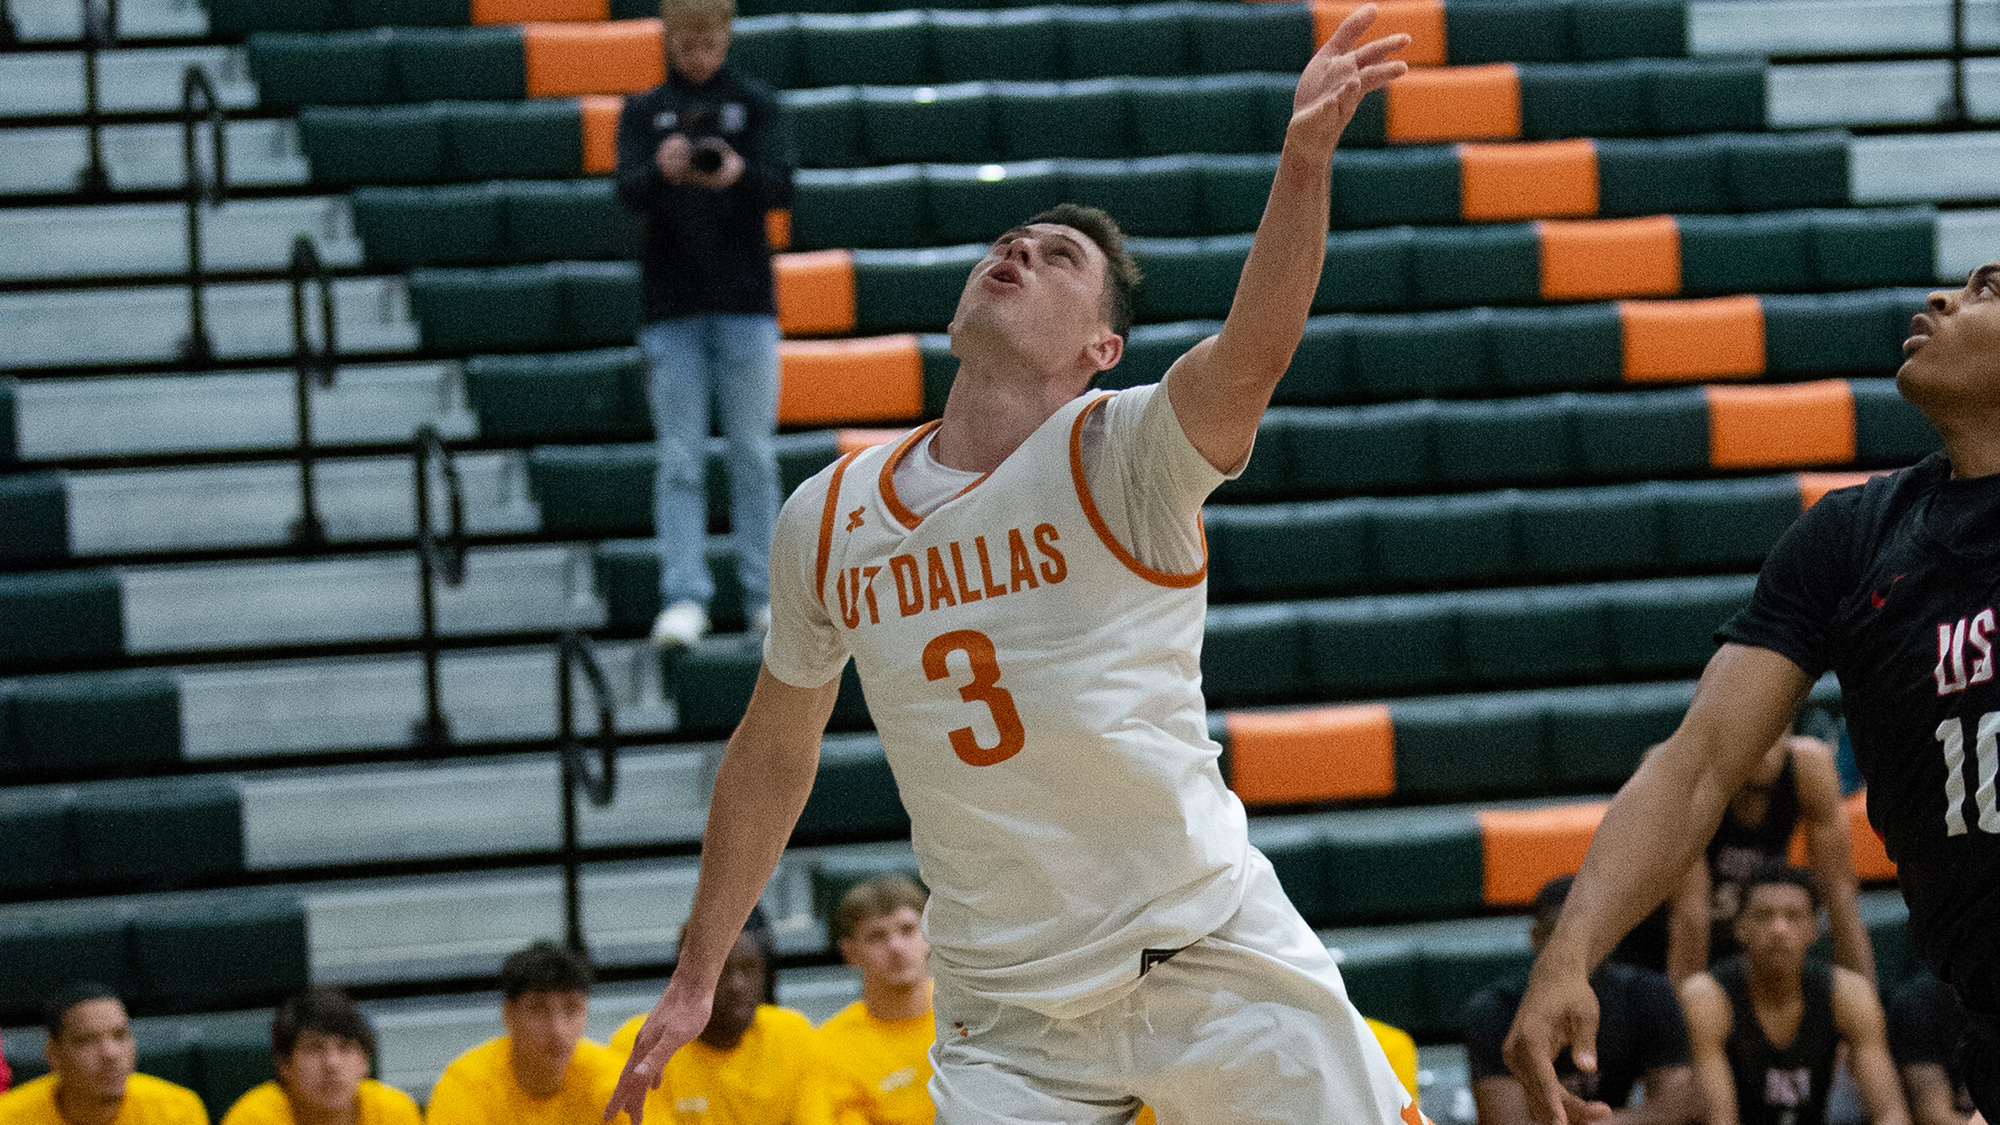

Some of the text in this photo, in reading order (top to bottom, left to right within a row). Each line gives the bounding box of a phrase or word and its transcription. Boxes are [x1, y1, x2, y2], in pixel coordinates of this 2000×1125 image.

[837, 522, 1068, 629] UT DALLAS
[921, 629, 1025, 767] 3
[1934, 608, 2000, 696] US
